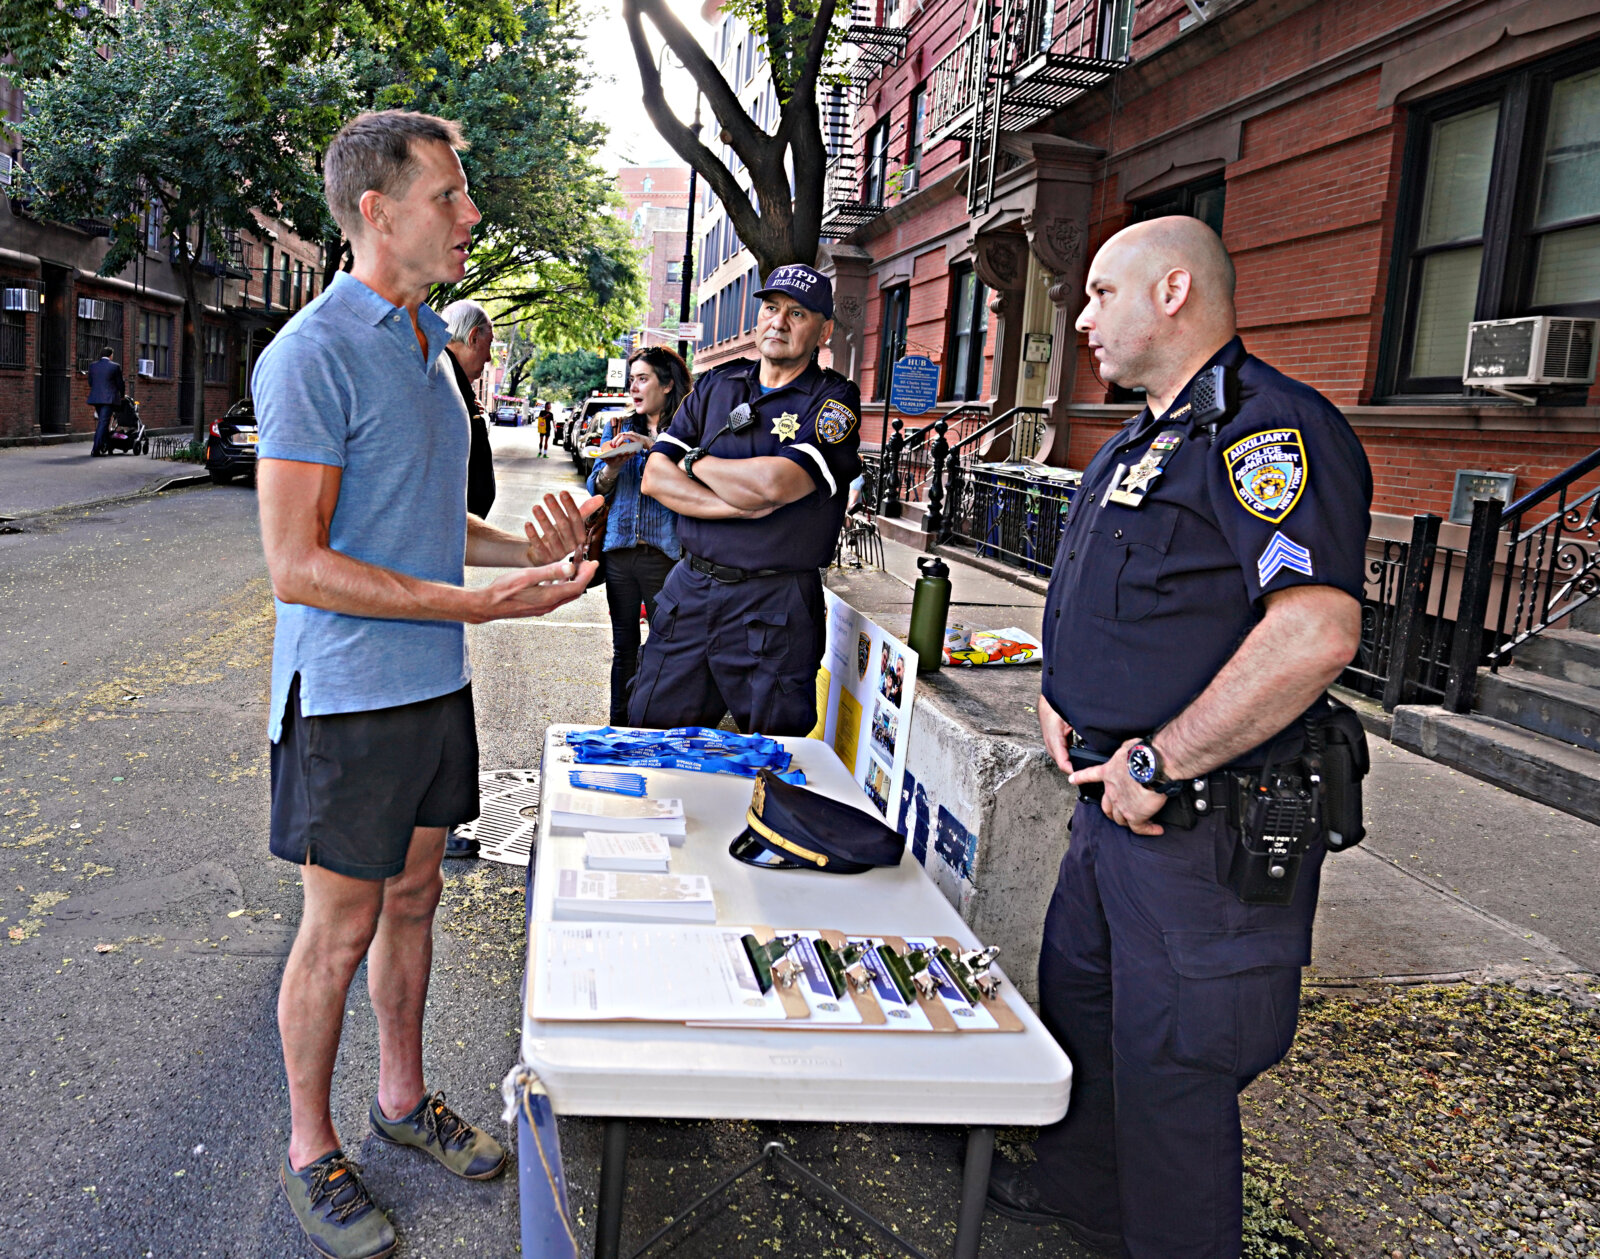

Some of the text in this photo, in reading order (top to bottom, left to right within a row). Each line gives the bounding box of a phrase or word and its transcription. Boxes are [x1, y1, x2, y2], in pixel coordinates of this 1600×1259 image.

[772, 278, 812, 293] AUXILIARY
[775, 268, 818, 284] NYPD
[610, 370, 623, 379] 25
[829, 402, 855, 421] AUXILIARY
[1230, 432, 1291, 460] AUXILIARY
[1244, 446, 1282, 464] POLICE
[1235, 453, 1299, 481] DEPARTMENT
[1278, 467, 1303, 510] NEW YORK
[1238, 487, 1267, 511] CITY OF
